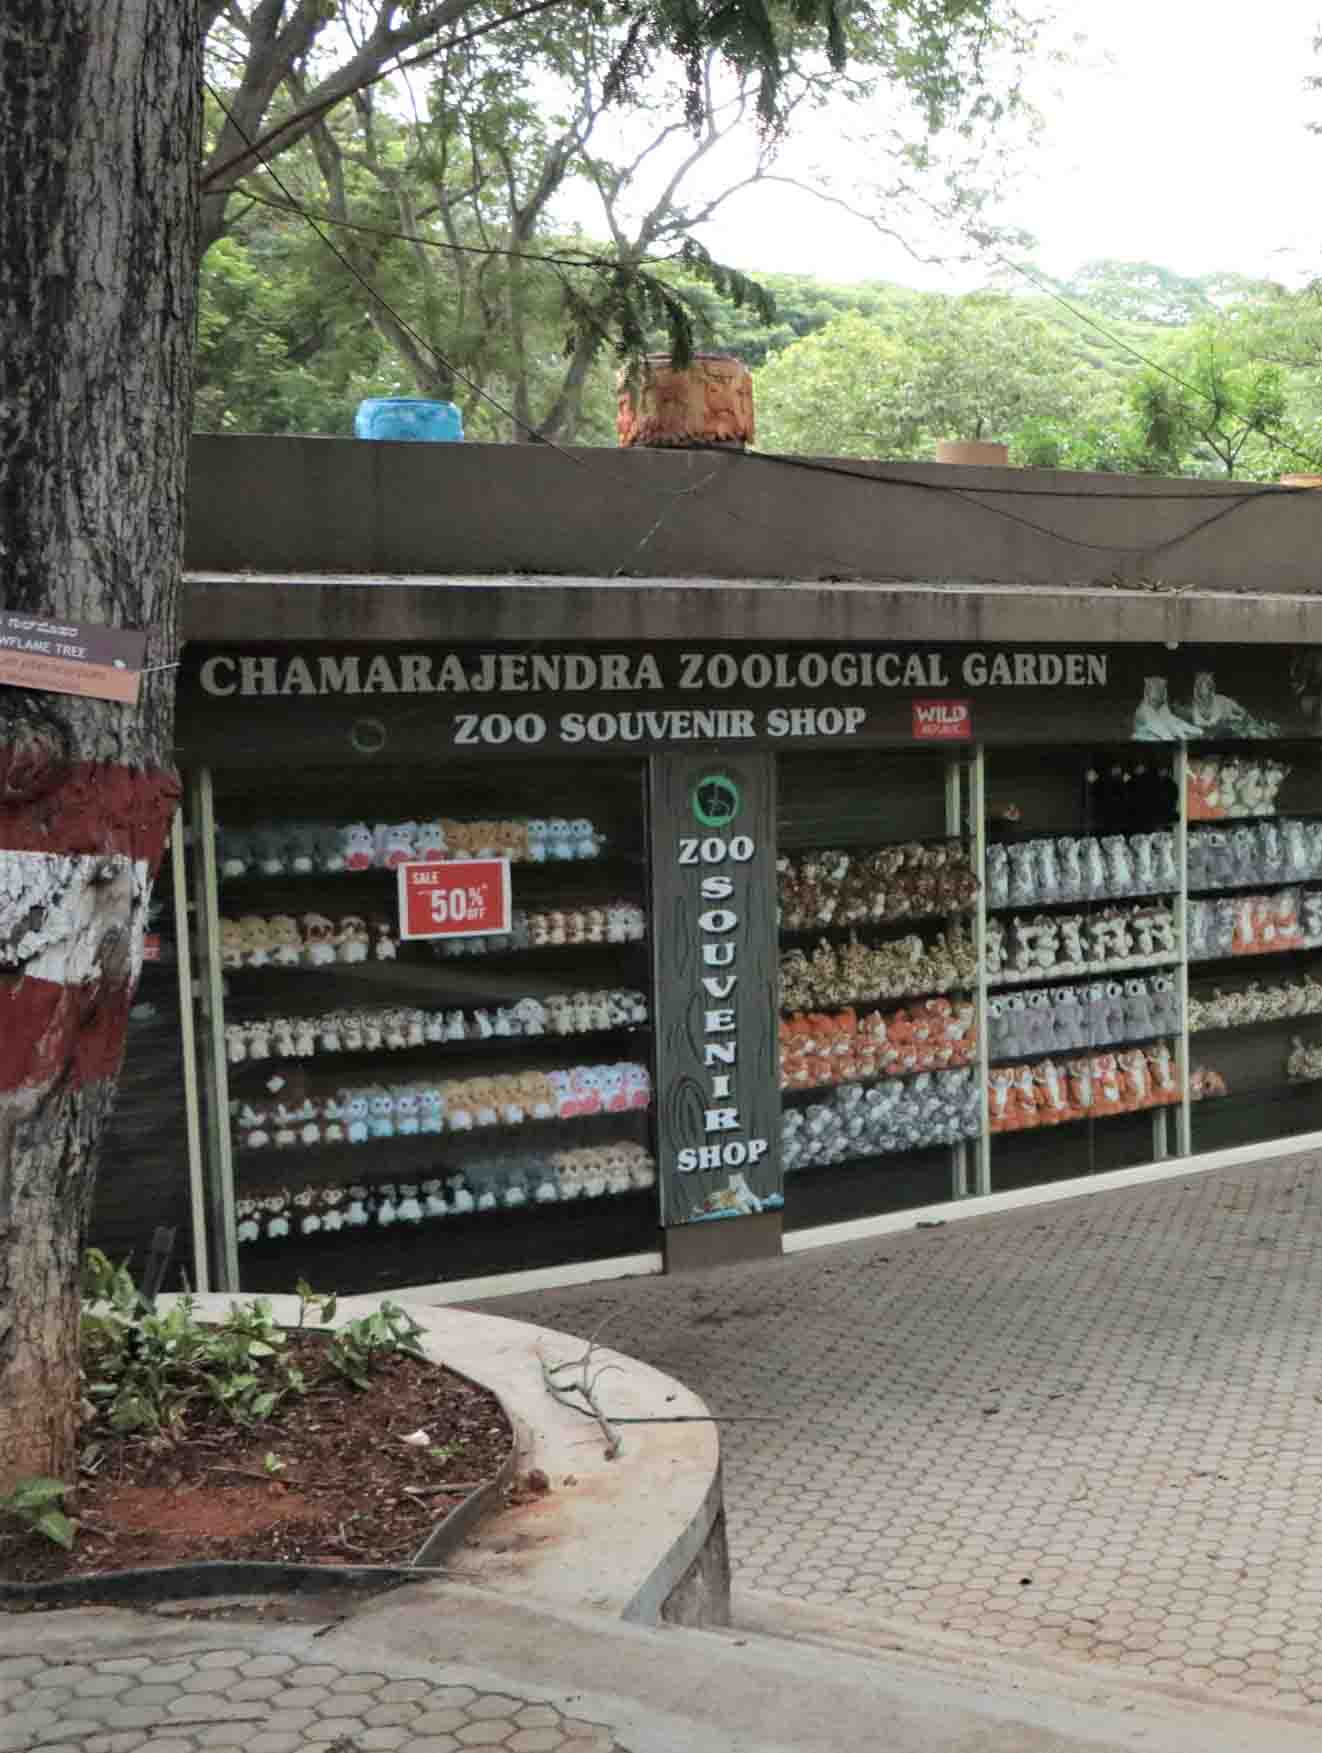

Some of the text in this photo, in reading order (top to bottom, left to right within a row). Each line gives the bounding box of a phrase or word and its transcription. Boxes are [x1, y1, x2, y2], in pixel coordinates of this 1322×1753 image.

[55, 642, 87, 659] TREE
[200, 653, 1108, 696] CHAMARAJENDRA ZOOLOGICAL GARDEN
[453, 707, 866, 744] ZOO SOUVENIR SHOP
[914, 705, 968, 723] WILD
[678, 836, 754, 864] ZOO
[412, 871, 440, 885] SALE
[698, 876, 740, 1132] SOUVENIR
[677, 1139, 768, 1171] SHOP
